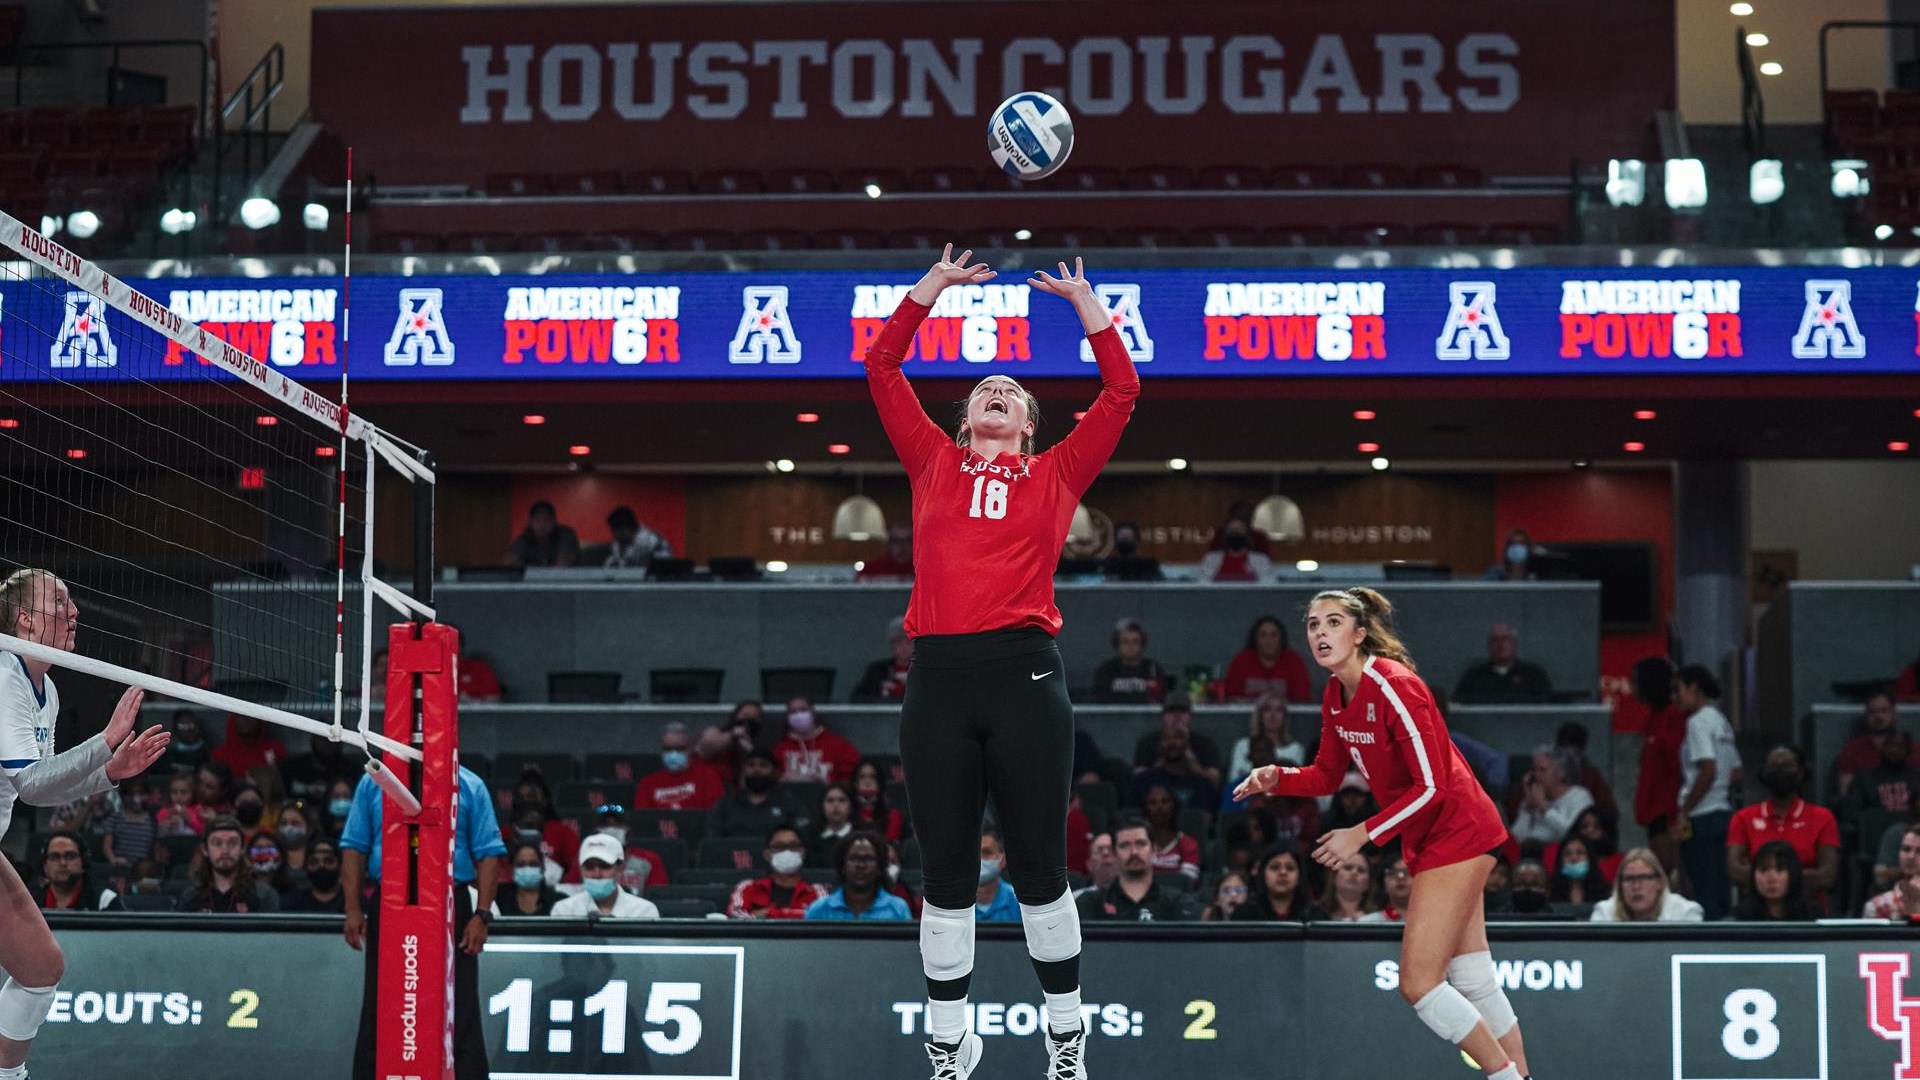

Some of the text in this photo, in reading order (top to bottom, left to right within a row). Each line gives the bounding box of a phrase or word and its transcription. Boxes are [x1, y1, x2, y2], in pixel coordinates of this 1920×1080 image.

[460, 33, 1521, 123] HOUSTON COUGARS
[997, 125, 1031, 169] molten
[21, 227, 82, 278] HOUSTON
[130, 290, 182, 335] HOUSTON
[222, 344, 268, 384] HOUSTON
[168, 288, 338, 323] AMERICAN
[504, 286, 681, 321] AMERICAN
[851, 284, 1031, 318] AMRICAN
[1204, 282, 1385, 317] AMERICAN
[1559, 279, 1741, 314] AMERICAN
[503, 317, 681, 365] POW6R
[850, 315, 1031, 363] PW6R
[1203, 313, 1387, 361] POW6R
[1559, 311, 1743, 360] POW6R
[968, 475, 1009, 520] 18
[768, 526, 826, 545] THE
[1311, 525, 1432, 544] HOUSTON
[1335, 725, 1376, 744] HSTON
[402, 934, 419, 991] sports
[1492, 958, 1584, 991] WON
[46, 988, 260, 1029] EOUTS: 2
[400, 992, 417, 1062] imports
[488, 977, 703, 1056] 1:15
[892, 998, 1217, 1040] TEOTS: 2
[1720, 987, 1781, 1060] 8
